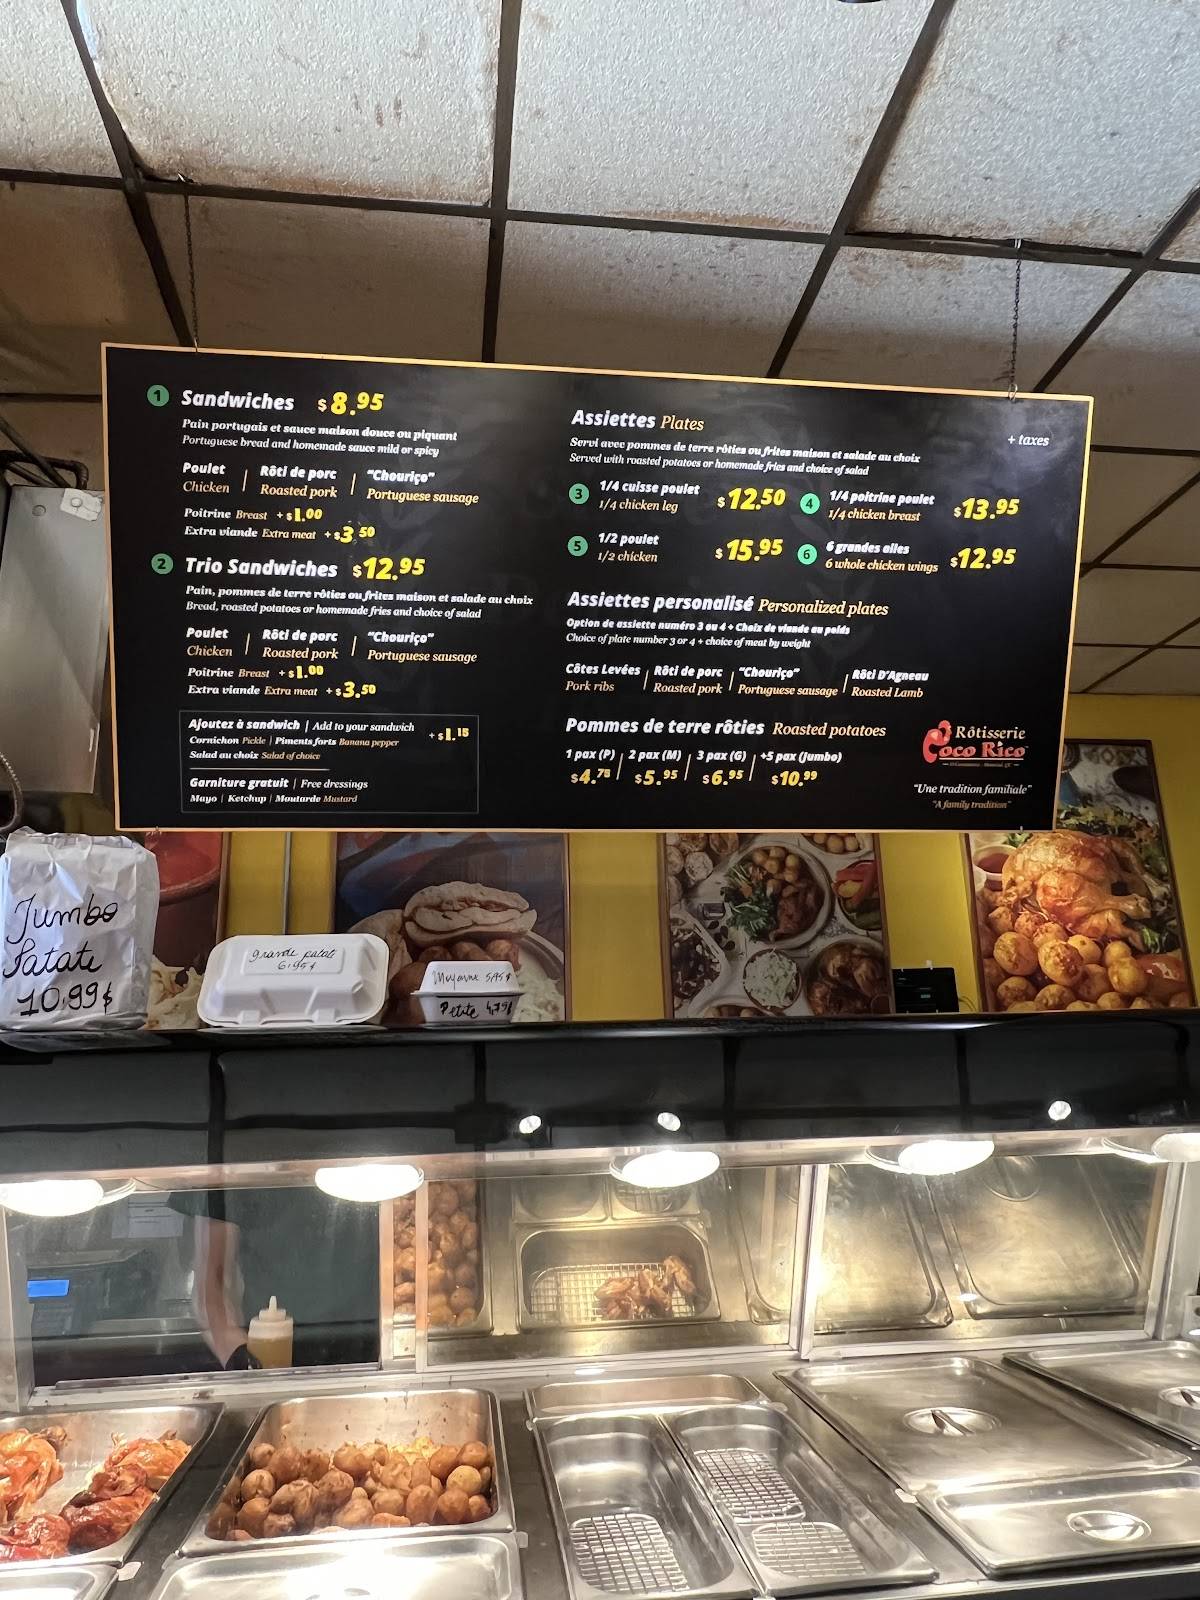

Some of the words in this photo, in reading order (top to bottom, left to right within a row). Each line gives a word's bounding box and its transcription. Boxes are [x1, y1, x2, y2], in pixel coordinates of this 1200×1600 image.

[153, 390, 161, 402] 1
[182, 390, 294, 410] Sandwiches
[571, 410, 656, 429] Assiettes
[661, 416, 704, 431] Plates
[182, 419, 209, 429] Pain
[211, 422, 268, 433] portugais
[270, 424, 281, 433] et
[283, 426, 316, 434] sauce
[318, 426, 359, 436] maison
[362, 427, 395, 438] douce
[397, 431, 411, 439] ou
[413, 430, 457, 441] piquant
[182, 435, 238, 446] Portuguese
[240, 437, 269, 448] bread
[271, 439, 290, 448] and
[293, 441, 346, 451] homemade
[348, 444, 375, 452] sauce
[377, 444, 399, 454] mild
[401, 446, 412, 454] or
[414, 446, 439, 457] spicy
[1019, 435, 1049, 446] taxes
[183, 462, 226, 474] Poulet
[260, 465, 287, 477] Rôti
[290, 466, 305, 478] de
[308, 470, 337, 481] porc
[183, 481, 230, 493] Chicken
[260, 484, 307, 496] Roasted
[310, 486, 338, 499] pork
[600, 481, 619, 491] 1/4
[622, 483, 658, 493] cuisse
[661, 484, 700, 496] poulet
[367, 489, 430, 503] Portuguese
[433, 491, 479, 505] sausage
[576, 489, 582, 499] 3
[599, 500, 617, 510] 1/4
[619, 501, 660, 511] chicken
[662, 502, 678, 514] leg
[806, 499, 813, 508] 4
[184, 508, 231, 519] Poitrine
[236, 510, 267, 520] Breast
[829, 508, 845, 520] 1/4
[847, 509, 886, 520] chicken
[888, 510, 920, 522] breast
[574, 541, 581, 551] 5
[599, 533, 617, 543] 1/2
[620, 534, 659, 546] poulet
[598, 552, 616, 562] 1/2
[618, 552, 657, 562] chicken
[803, 549, 811, 559] 6
[157, 558, 166, 569] 2
[185, 557, 222, 574] Trio
[227, 558, 338, 578] Sandwiches
[825, 559, 832, 569] 6
[834, 560, 865, 570] whole
[867, 561, 905, 572] chicken
[908, 563, 939, 574] wings
[567, 592, 650, 608] Assiettes
[653, 595, 754, 613] personalisé
[759, 599, 845, 615] Personalized
[847, 601, 888, 617] plates
[186, 627, 229, 639] Poulet
[262, 629, 289, 641] Rôti
[292, 630, 307, 641] de
[309, 633, 338, 643] porc
[187, 645, 232, 657] Chicken
[262, 647, 309, 659] Roasted
[311, 649, 338, 661] pork
[367, 649, 430, 663] Portuguese
[432, 651, 477, 664] sausage
[188, 668, 233, 678] Poitrine
[238, 669, 269, 678] Breast
[566, 663, 599, 674] Côtes
[601, 664, 641, 675] Levées
[654, 665, 679, 676] Rôti
[681, 666, 695, 676] de
[697, 668, 723, 679] porc
[852, 670, 875, 680] Rôti
[188, 685, 219, 694] Extra
[222, 686, 260, 695] viande
[265, 686, 292, 696] Extra
[294, 687, 318, 696] meat
[566, 681, 591, 691] Pork
[593, 681, 614, 692] ribs
[654, 682, 696, 693] Roasted
[698, 683, 723, 695] pork
[738, 684, 795, 696] Portuguese
[797, 688, 838, 697] sausage
[852, 686, 892, 697] Roasted
[894, 688, 923, 698] Lamb
[188, 719, 234, 731] Ajoutez
[237, 719, 244, 729] à
[246, 719, 300, 730] sandwich
[312, 722, 332, 731] Add
[334, 723, 344, 731] to
[346, 723, 368, 734] your
[370, 722, 414, 732] sandwich
[566, 718, 639, 733] Pommes
[643, 718, 664, 734] de
[668, 721, 711, 734] terre
[715, 720, 765, 735] rôties
[773, 723, 826, 736] Roasted
[829, 724, 886, 738] potatoes
[955, 726, 1025, 739] Rôtisserie
[566, 750, 572, 759] 1
[575, 751, 596, 761] pax
[599, 750, 615, 761] (P)
[628, 750, 635, 759] 2
[638, 751, 659, 761] pax
[662, 750, 681, 761] (M)
[981, 741, 1025, 757] Rico
[697, 751, 704, 760] 3
[706, 753, 728, 762] pax
[730, 751, 746, 762] (G)
[761, 752, 774, 761] +5
[775, 753, 797, 763] pax
[799, 751, 842, 763] (Jumbo)
[190, 778, 246, 788] Garniture
[248, 778, 288, 789] gratuit
[301, 779, 322, 788] Free
[324, 779, 368, 789] dressings
[939, 784, 982, 794] tradition
[6, 894, 118, 944] Jumbo
[3, 938, 102, 978] Patate
[249, 948, 298, 962] grande
[440, 1001, 480, 1018] Petite
